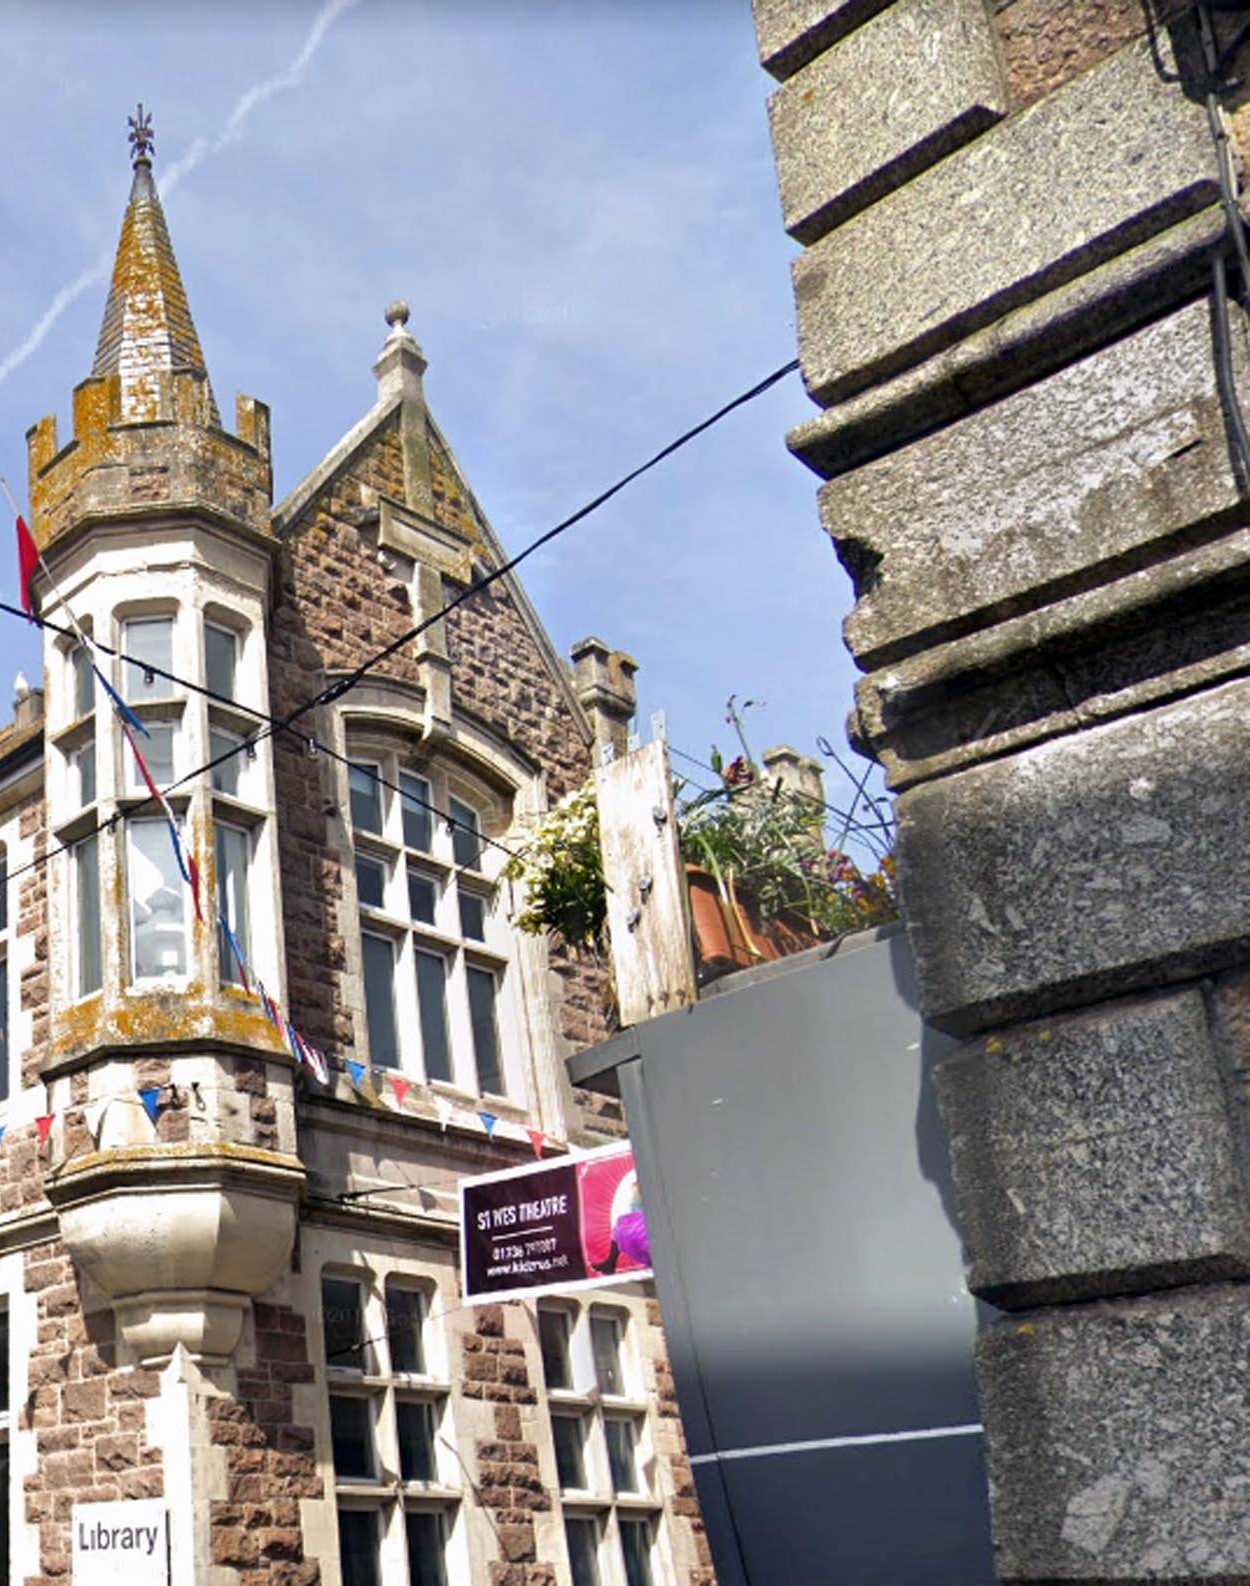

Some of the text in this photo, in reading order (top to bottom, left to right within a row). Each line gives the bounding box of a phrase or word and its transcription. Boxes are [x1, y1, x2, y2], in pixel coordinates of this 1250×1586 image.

[477, 1195, 567, 1230] ST IVES THEATRE
[79, 1521, 158, 1555] Library
